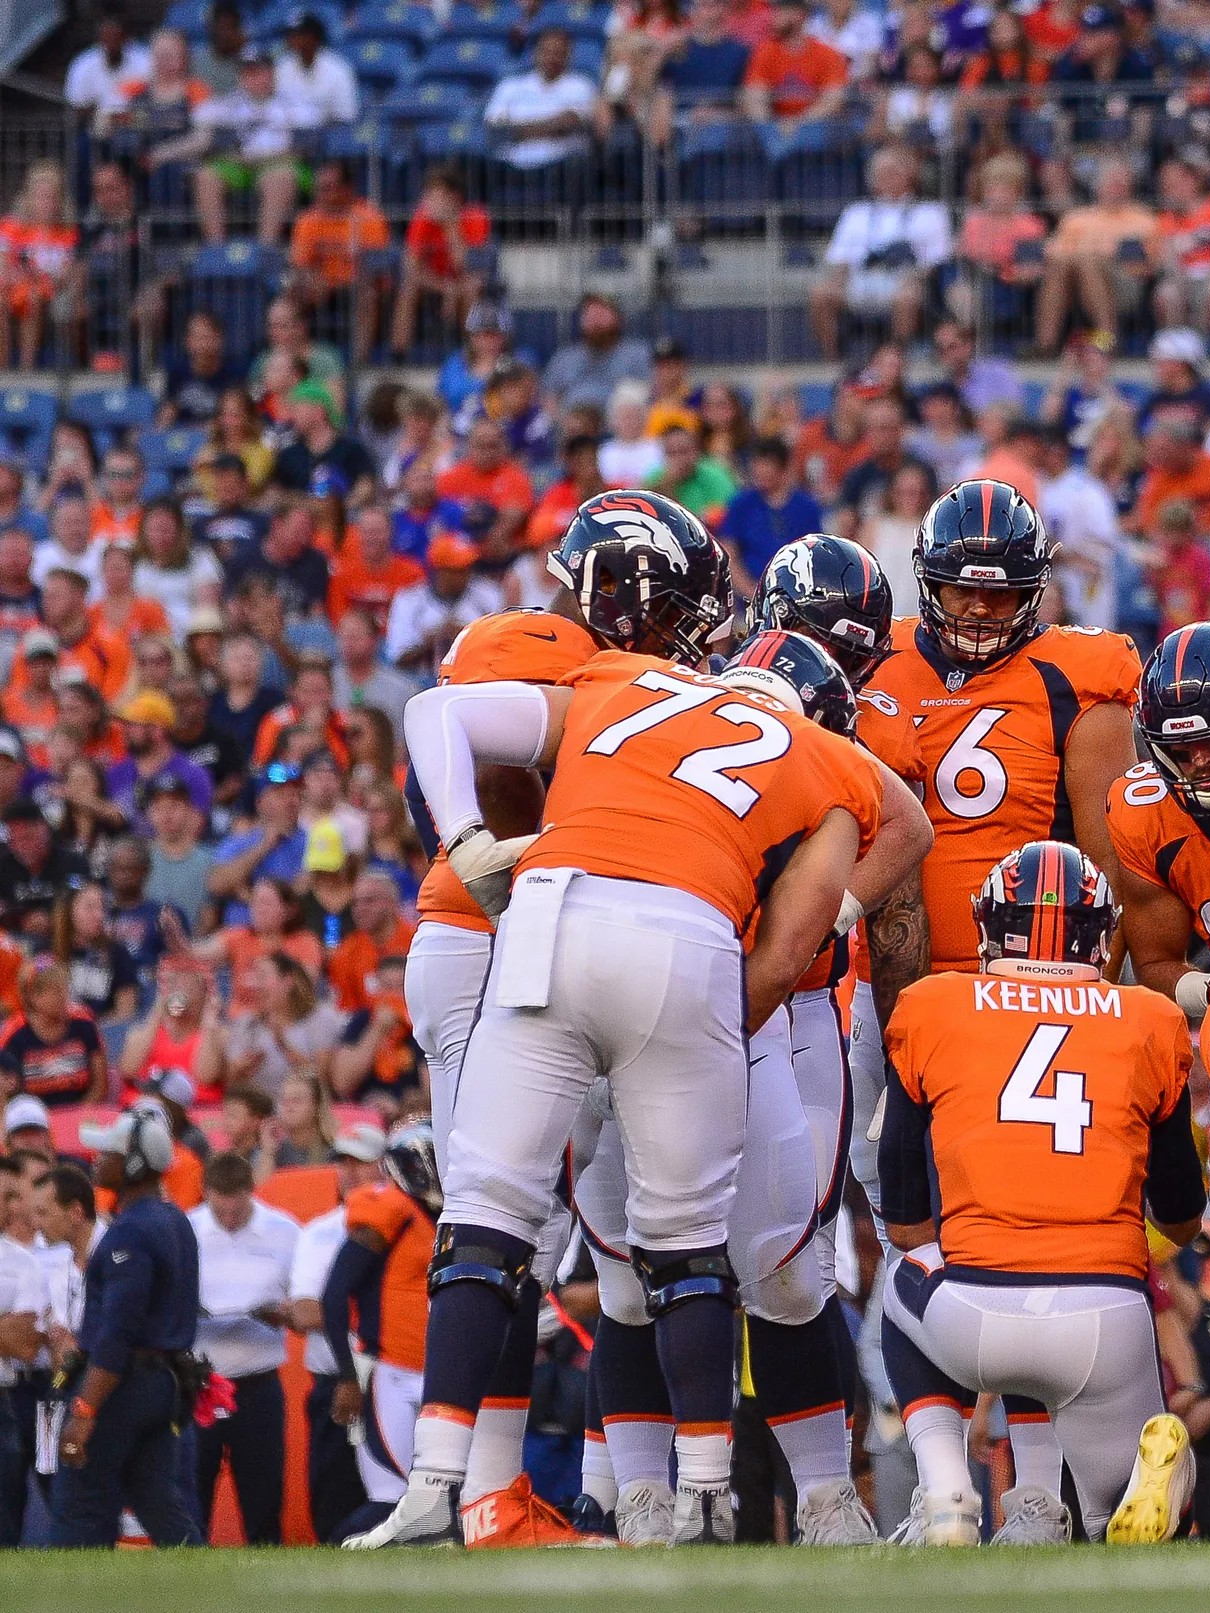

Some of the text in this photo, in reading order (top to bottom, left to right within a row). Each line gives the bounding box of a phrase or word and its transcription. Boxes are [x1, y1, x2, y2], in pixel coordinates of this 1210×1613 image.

[970, 569, 996, 578] BRONCOS
[774, 656, 796, 673] 72
[670, 664, 791, 712] BOES
[920, 698, 972, 706] BRONCOS
[585, 669, 792, 819] 72
[911, 707, 1009, 820] 6
[1070, 940, 1079, 954] 4
[1016, 965, 1074, 976] BRONCOS
[972, 980, 1122, 1018] KEENUM
[997, 1022, 1093, 1156] 4
